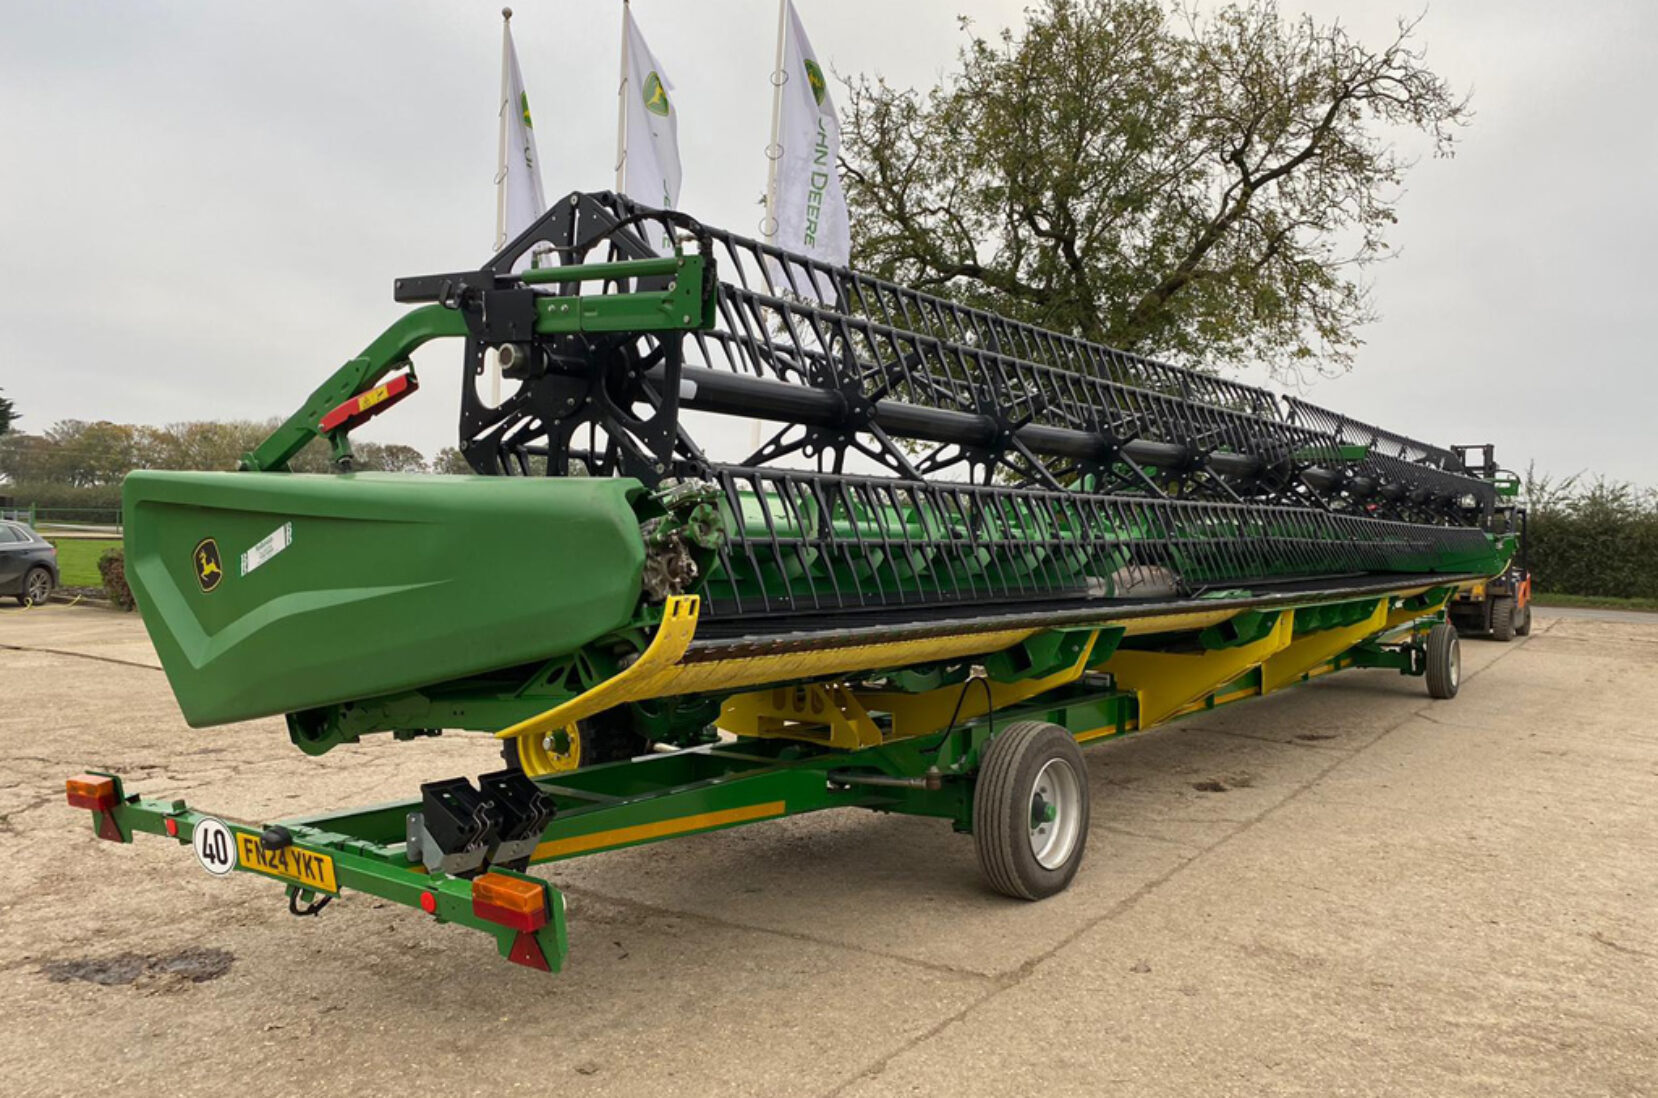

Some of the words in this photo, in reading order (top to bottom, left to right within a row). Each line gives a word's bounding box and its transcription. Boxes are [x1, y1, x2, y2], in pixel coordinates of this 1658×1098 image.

[813, 116, 829, 167] HN
[804, 171, 828, 249] DEERE
[202, 828, 228, 865] 40
[243, 838, 289, 872] FN24
[291, 850, 325, 883] YKT
